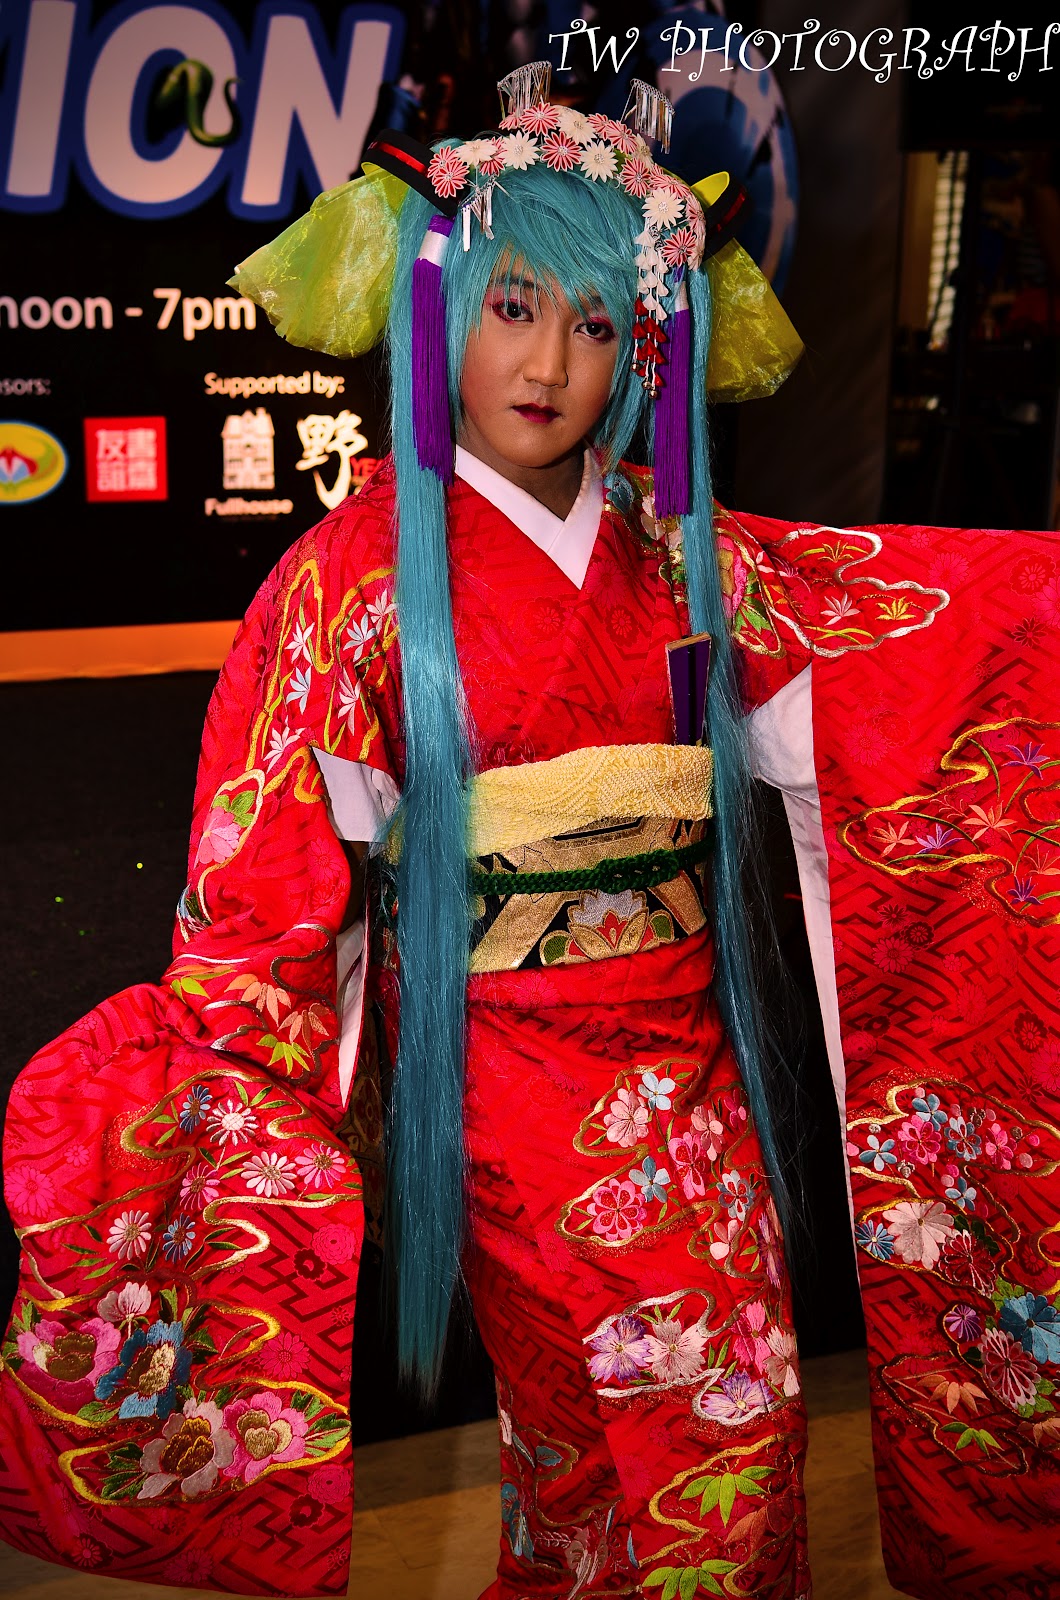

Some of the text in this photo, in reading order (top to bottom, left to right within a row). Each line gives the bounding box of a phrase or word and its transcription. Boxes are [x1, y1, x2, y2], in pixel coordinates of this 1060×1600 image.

[153, 288, 256, 341] 7pm
[204, 370, 345, 399] Supported by:
